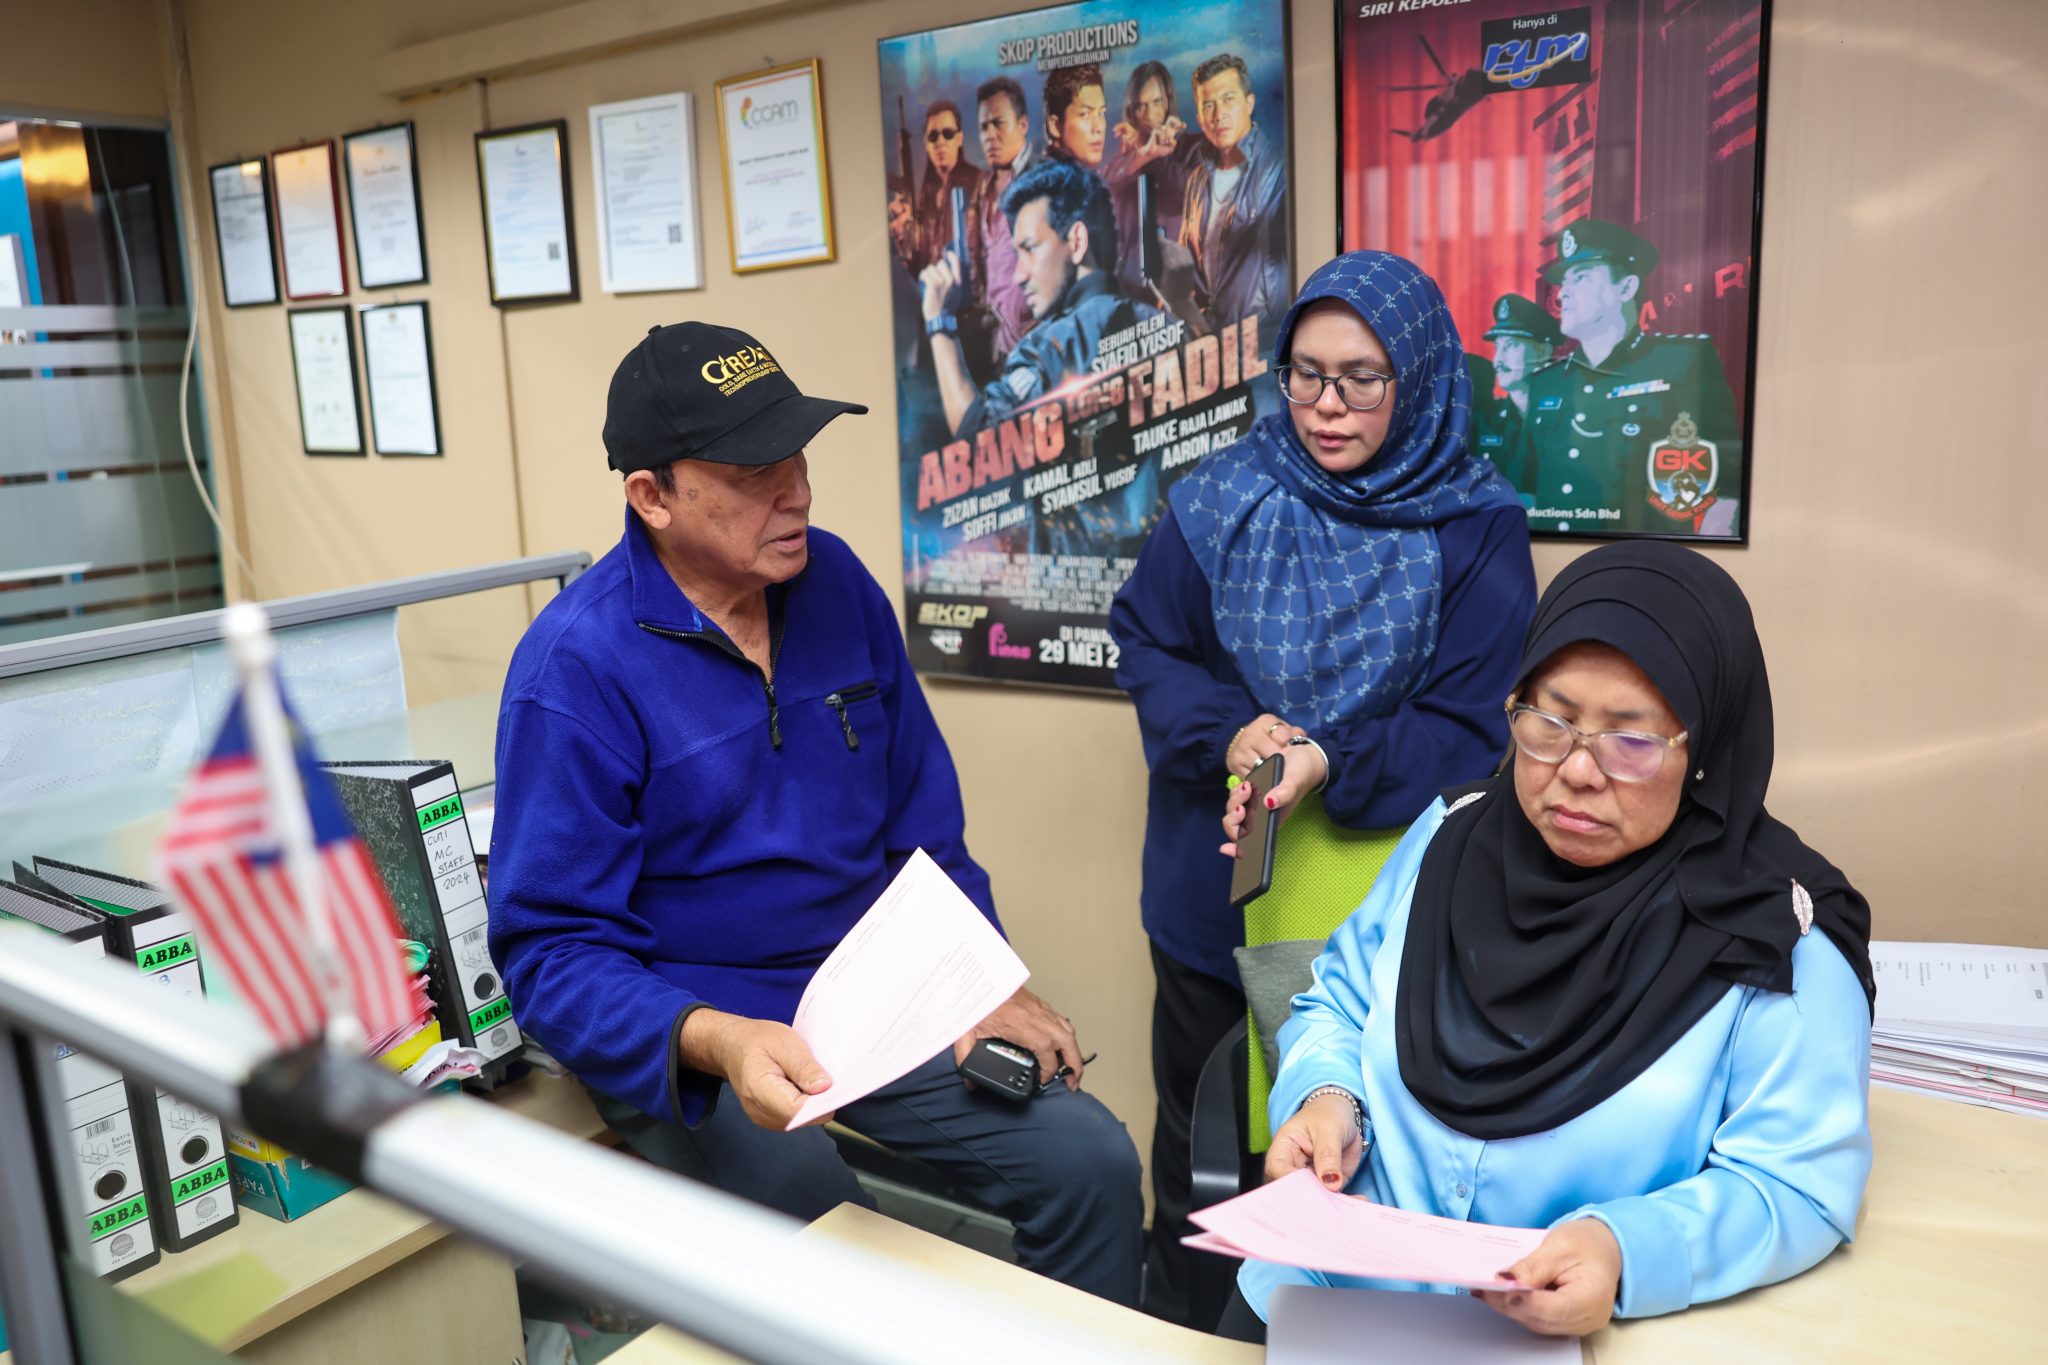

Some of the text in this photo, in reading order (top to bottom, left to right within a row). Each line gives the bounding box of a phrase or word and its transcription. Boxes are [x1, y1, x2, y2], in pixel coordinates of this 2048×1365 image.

[1359, 0, 1472, 18] SIRI KEPO
[1513, 14, 1558, 30] Hanya di
[998, 19, 1138, 65] SKOP PRODUCTIONS
[1096, 312, 1166, 354] SEBUAH FILEM
[1138, 319, 1186, 360] YUSOF
[917, 401, 1066, 512] ABANG
[1127, 313, 1269, 429] FADIL
[1132, 395, 1248, 457] TAUKE RAJA LAWAK
[1161, 426, 1239, 471] AARON AZIZ
[1655, 449, 1708, 471] GK
[1023, 457, 1098, 499] KAMAL ADLI
[1041, 463, 1138, 515] SYAMSUL YUSOF
[942, 486, 1012, 528] ZIZAN RAZAK
[1526, 506, 1621, 520] ductions Sdn Bhd
[918, 602, 989, 628] SKOP
[1059, 624, 1116, 645] DI PAWA
[1038, 637, 1066, 665] 29
[1067, 641, 1104, 668] MEI
[422, 801, 460, 826] ABBA
[434, 845, 454, 862] MC
[438, 855, 465, 875] STAFF
[443, 872, 471, 890] 2024
[142, 940, 194, 969] ABBA
[474, 1001, 511, 1029] ABBA
[111, 1132, 131, 1144] Extra
[112, 1138, 132, 1151] Strong
[177, 1166, 227, 1198] ABBA
[90, 1201, 144, 1235] ABBA
